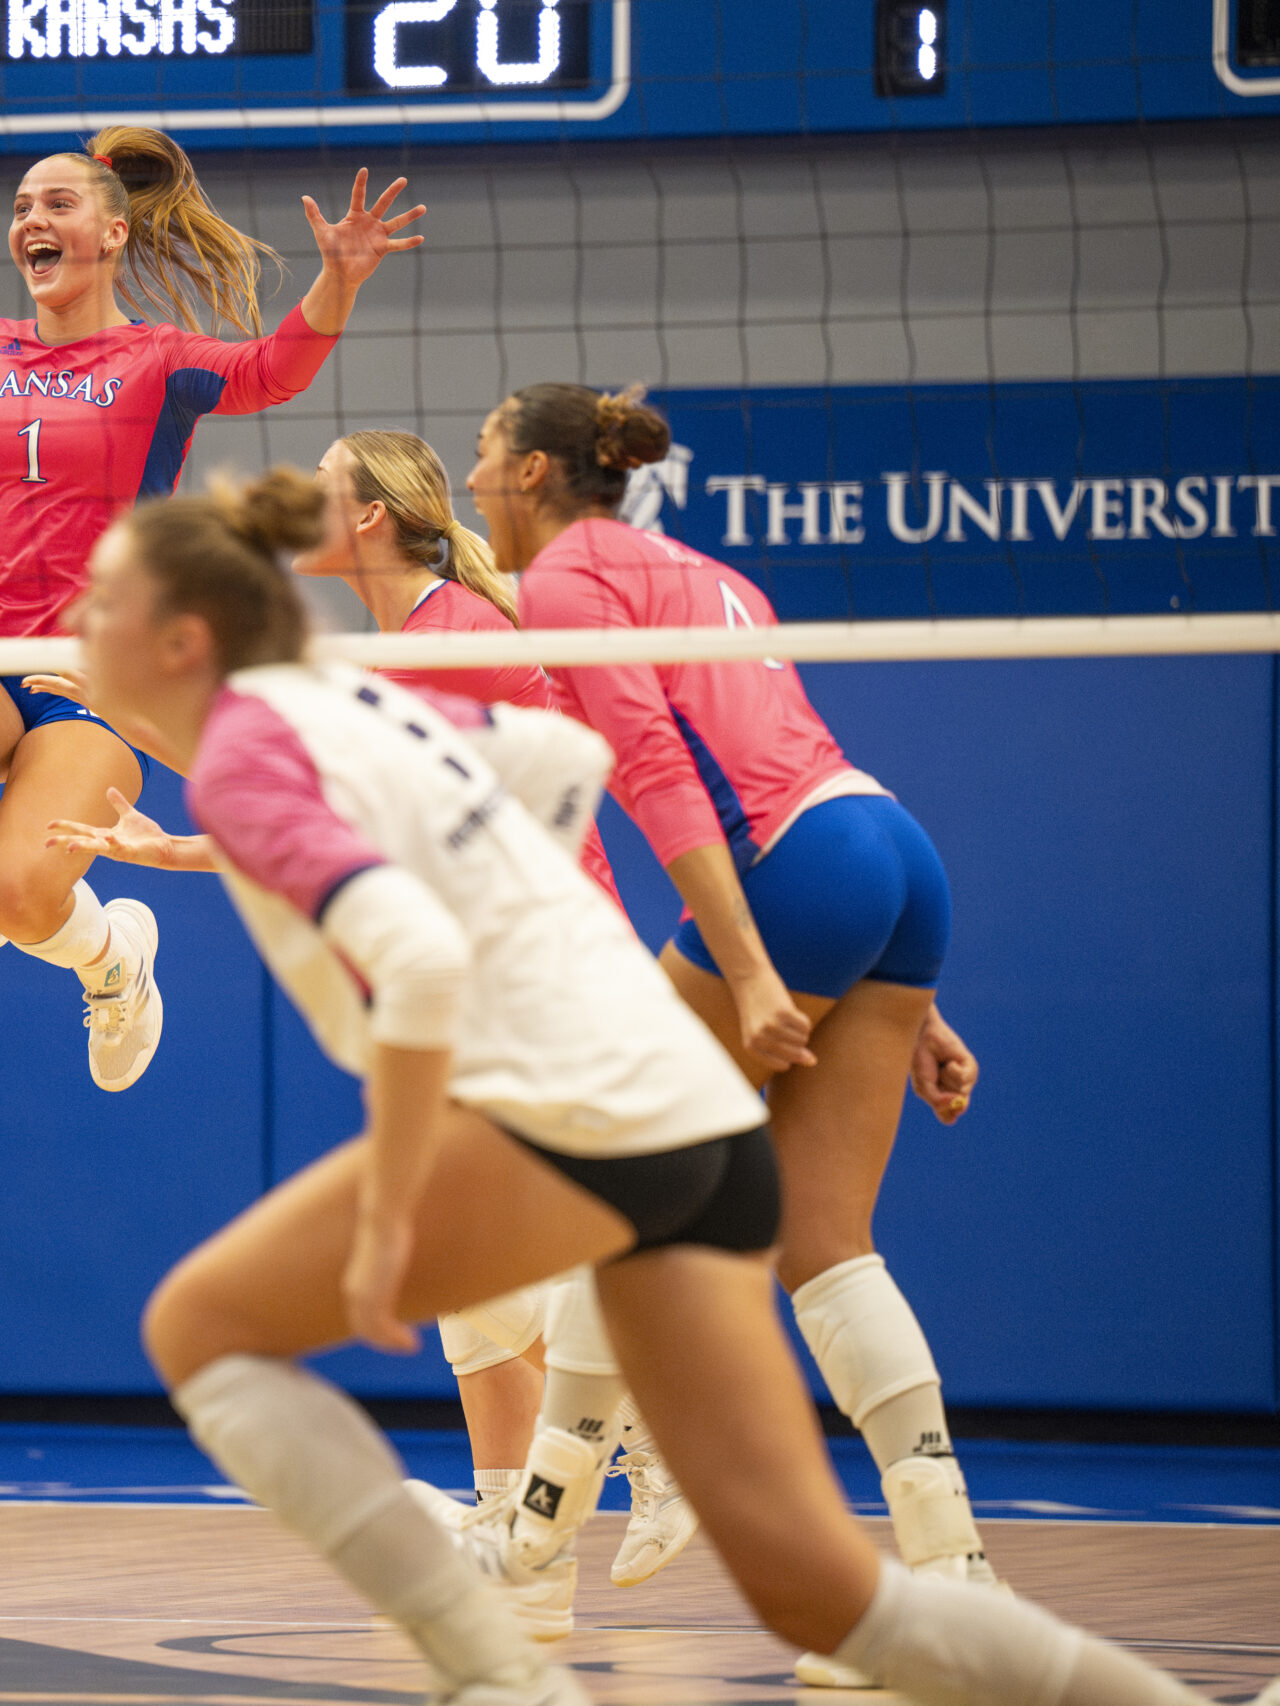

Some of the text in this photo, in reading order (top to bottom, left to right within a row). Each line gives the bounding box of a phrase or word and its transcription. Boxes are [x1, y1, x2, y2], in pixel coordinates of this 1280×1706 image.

[8, 0, 235, 58] KANSAS
[373, 0, 561, 87] 20
[918, 8, 937, 80] 1
[18, 418, 48, 483] 1
